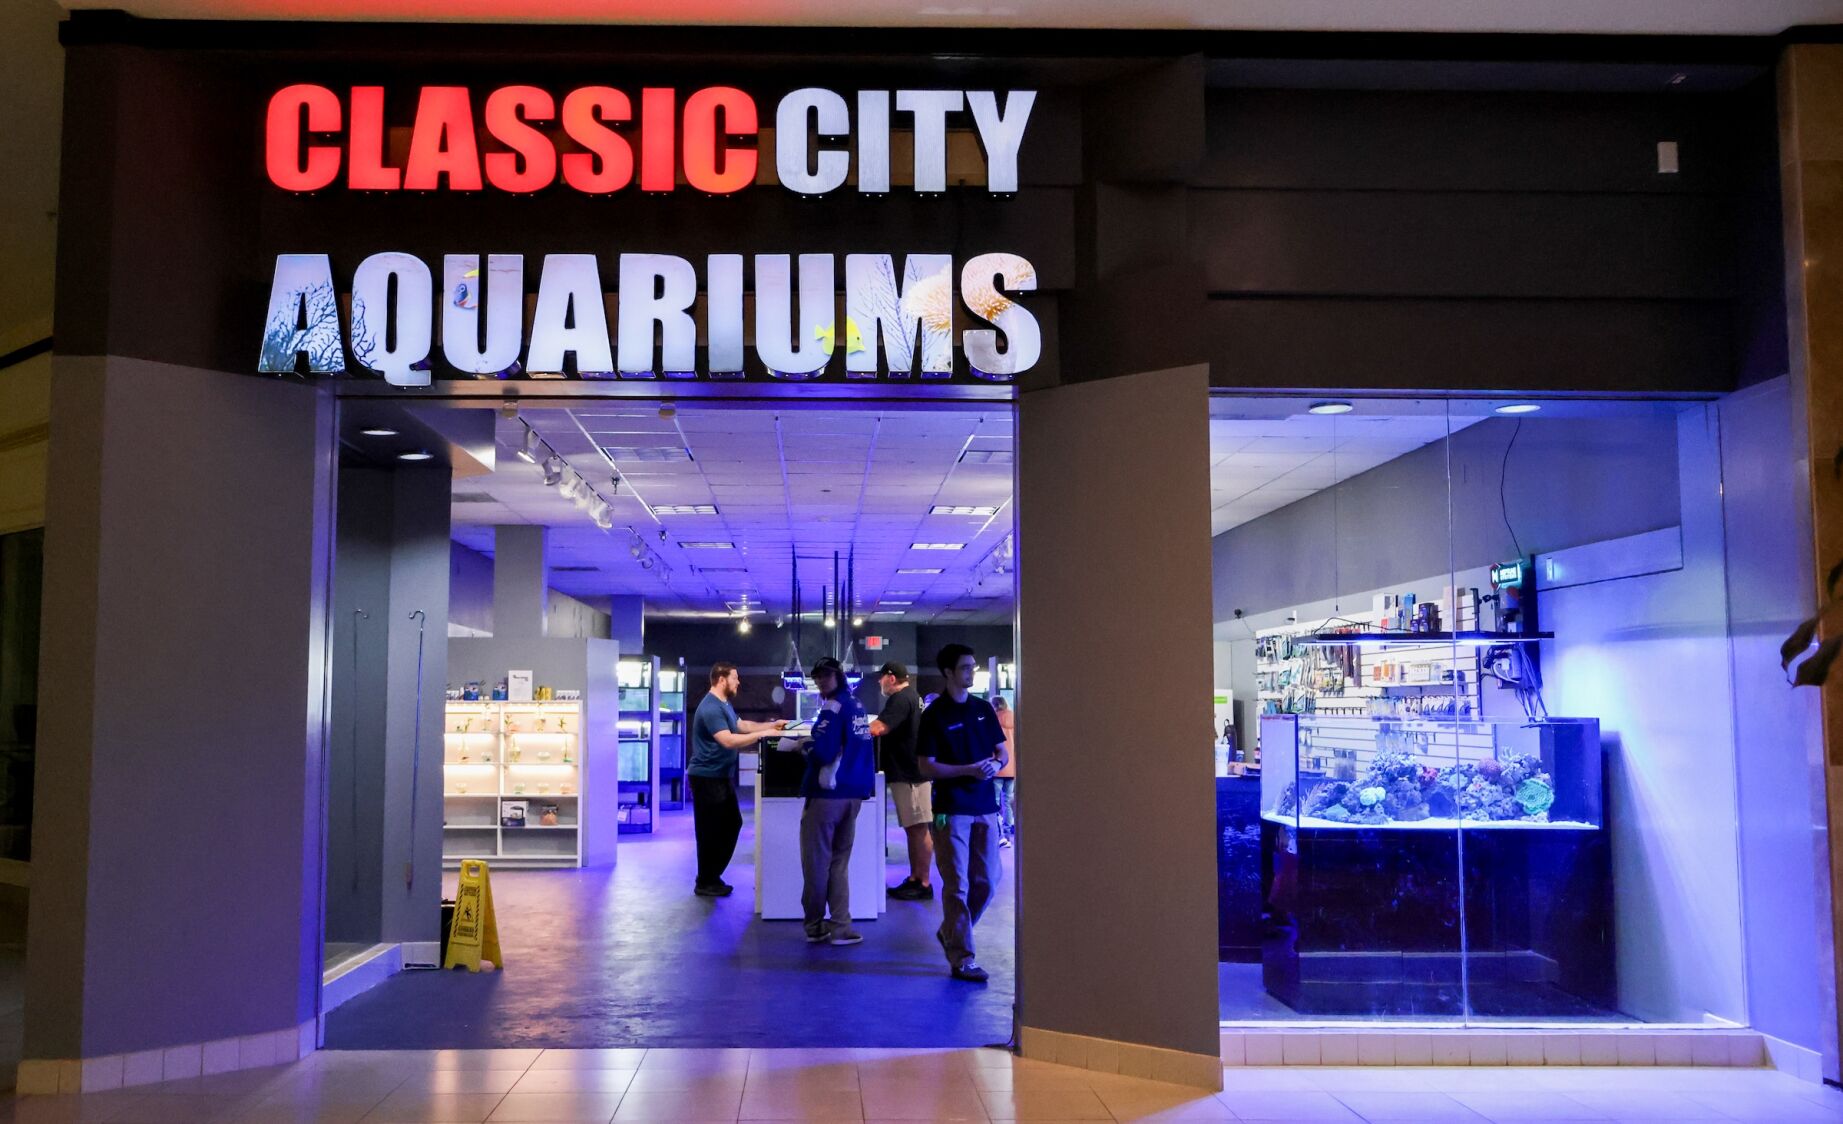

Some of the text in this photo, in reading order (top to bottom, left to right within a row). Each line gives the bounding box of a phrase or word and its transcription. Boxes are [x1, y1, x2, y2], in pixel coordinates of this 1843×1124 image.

[265, 83, 1038, 195] CLASSIC CITY
[257, 251, 1042, 386] AQUARIUMS
